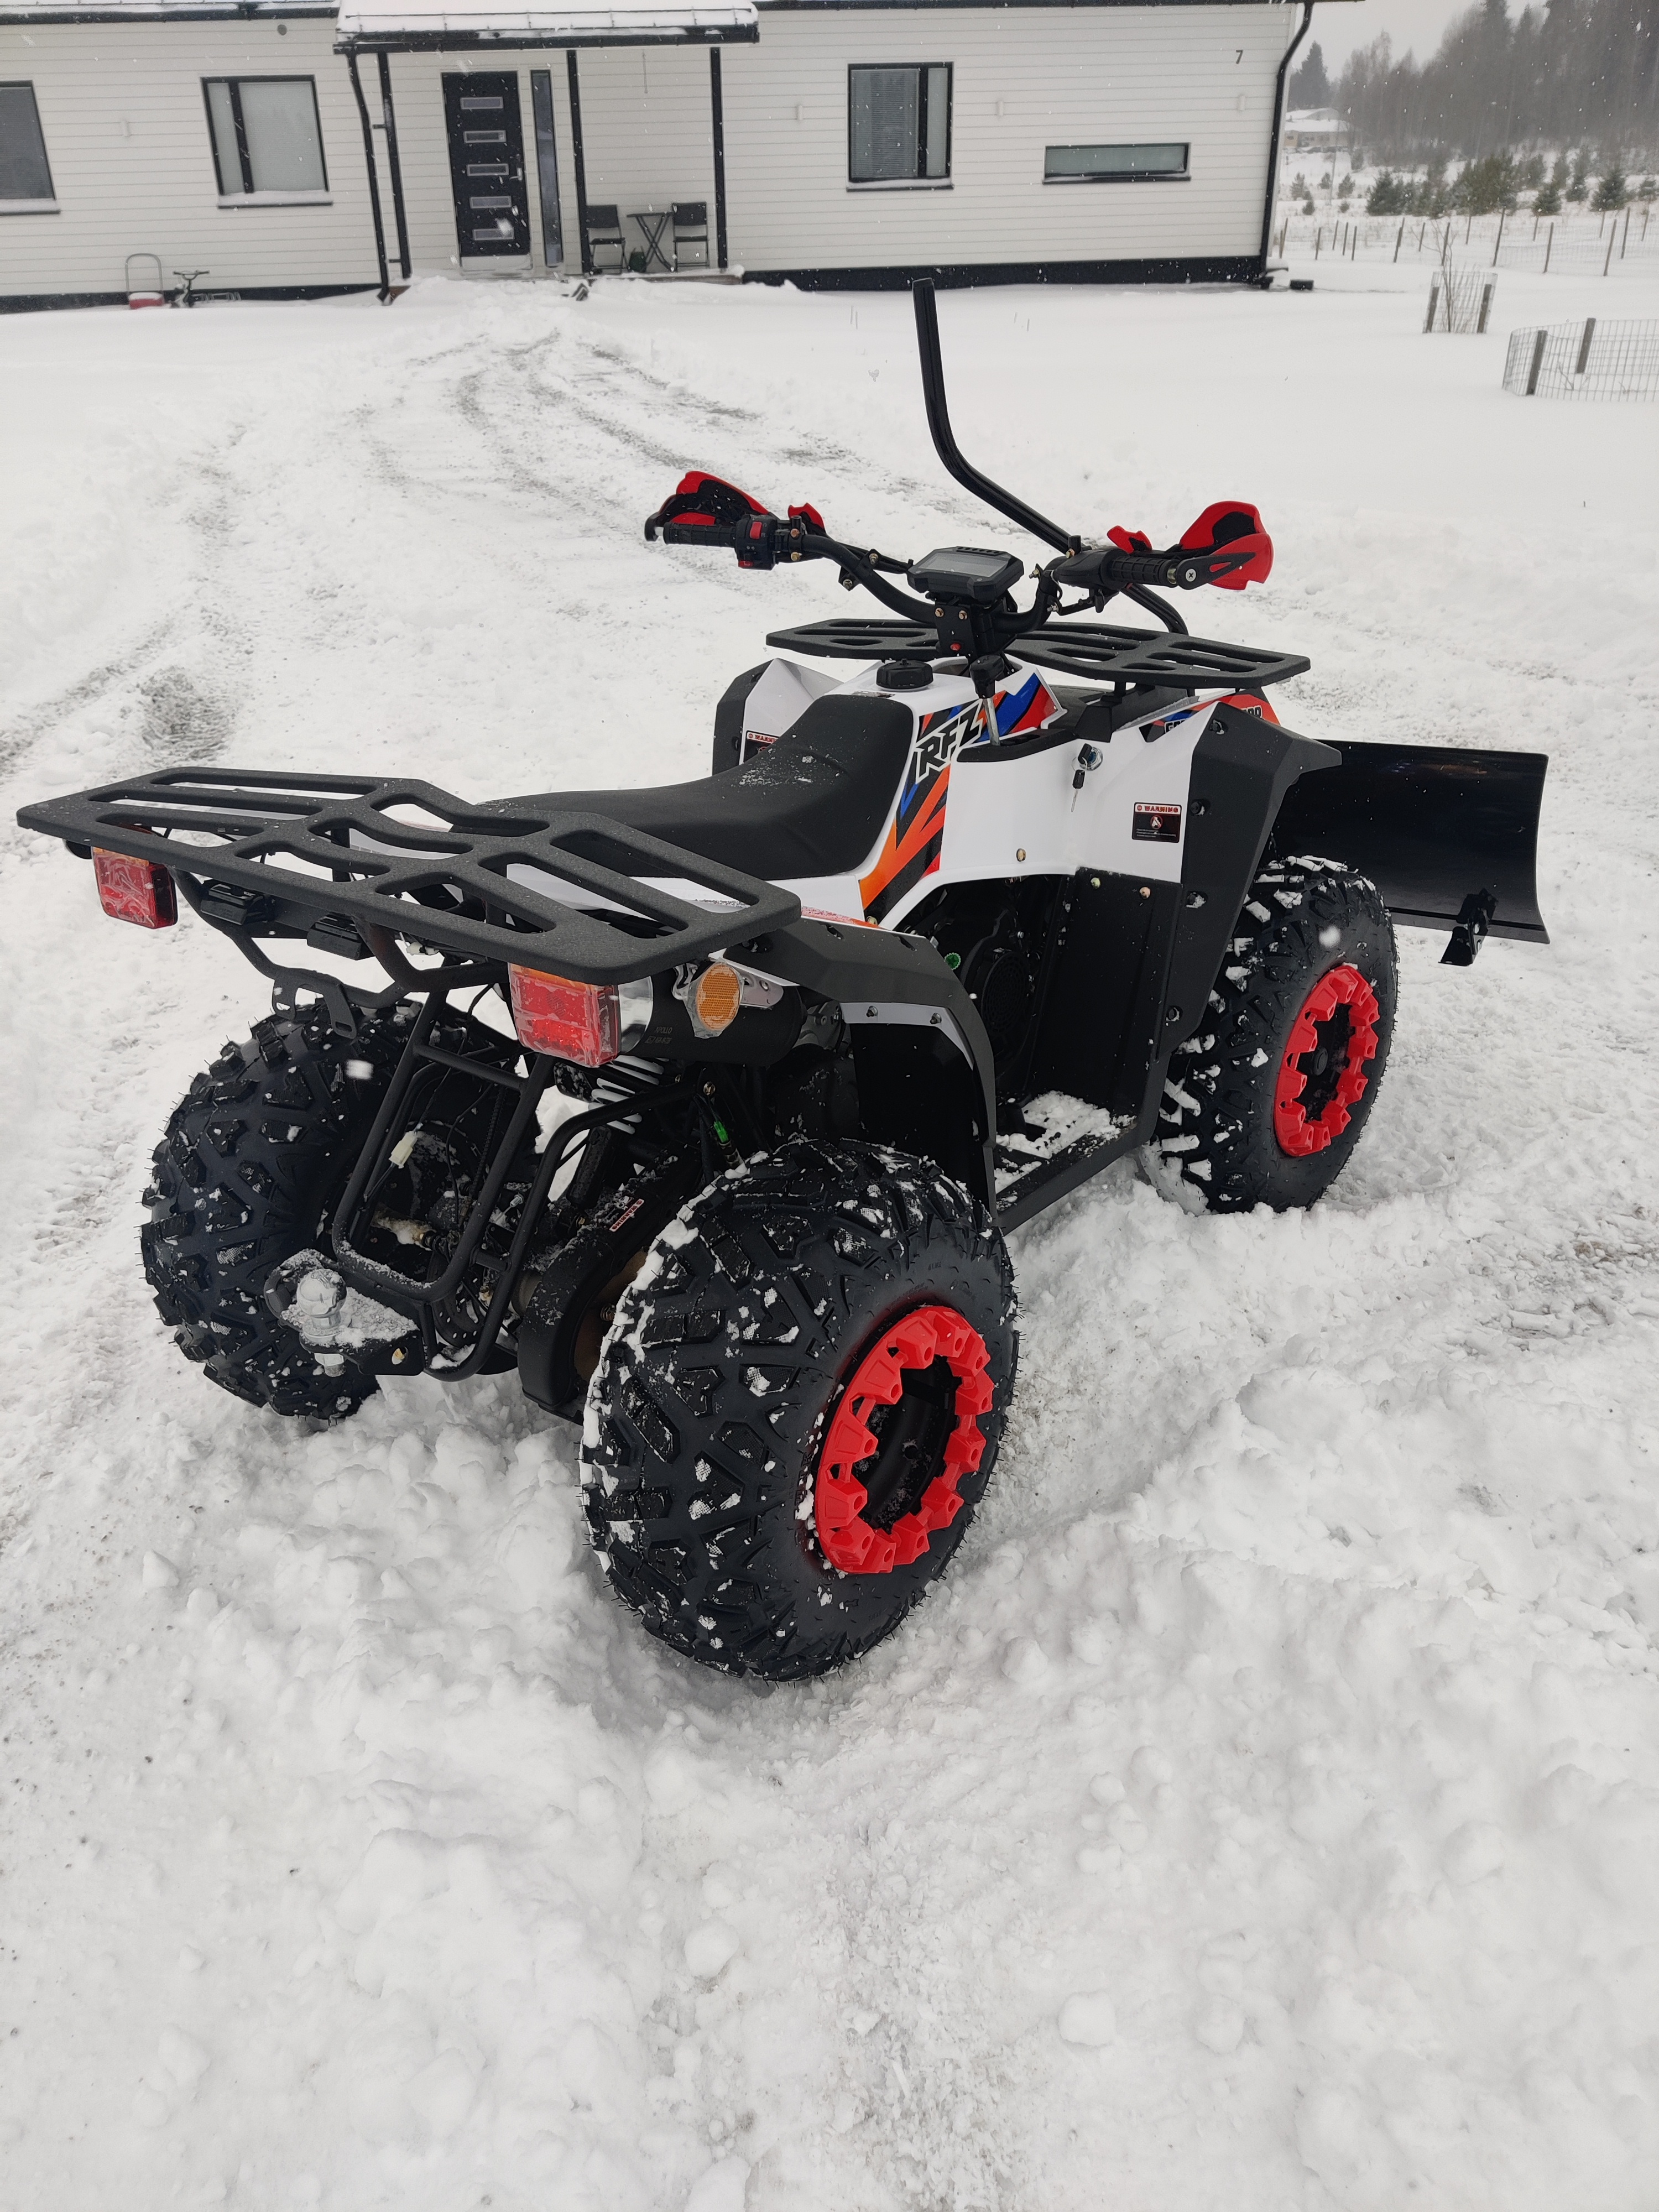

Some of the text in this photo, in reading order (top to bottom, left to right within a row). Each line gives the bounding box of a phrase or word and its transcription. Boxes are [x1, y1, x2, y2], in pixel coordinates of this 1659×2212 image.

[1236, 50, 1243, 64] 7
[915, 701, 982, 782] RFZ
[612, 1206, 638, 1230] WARNING
